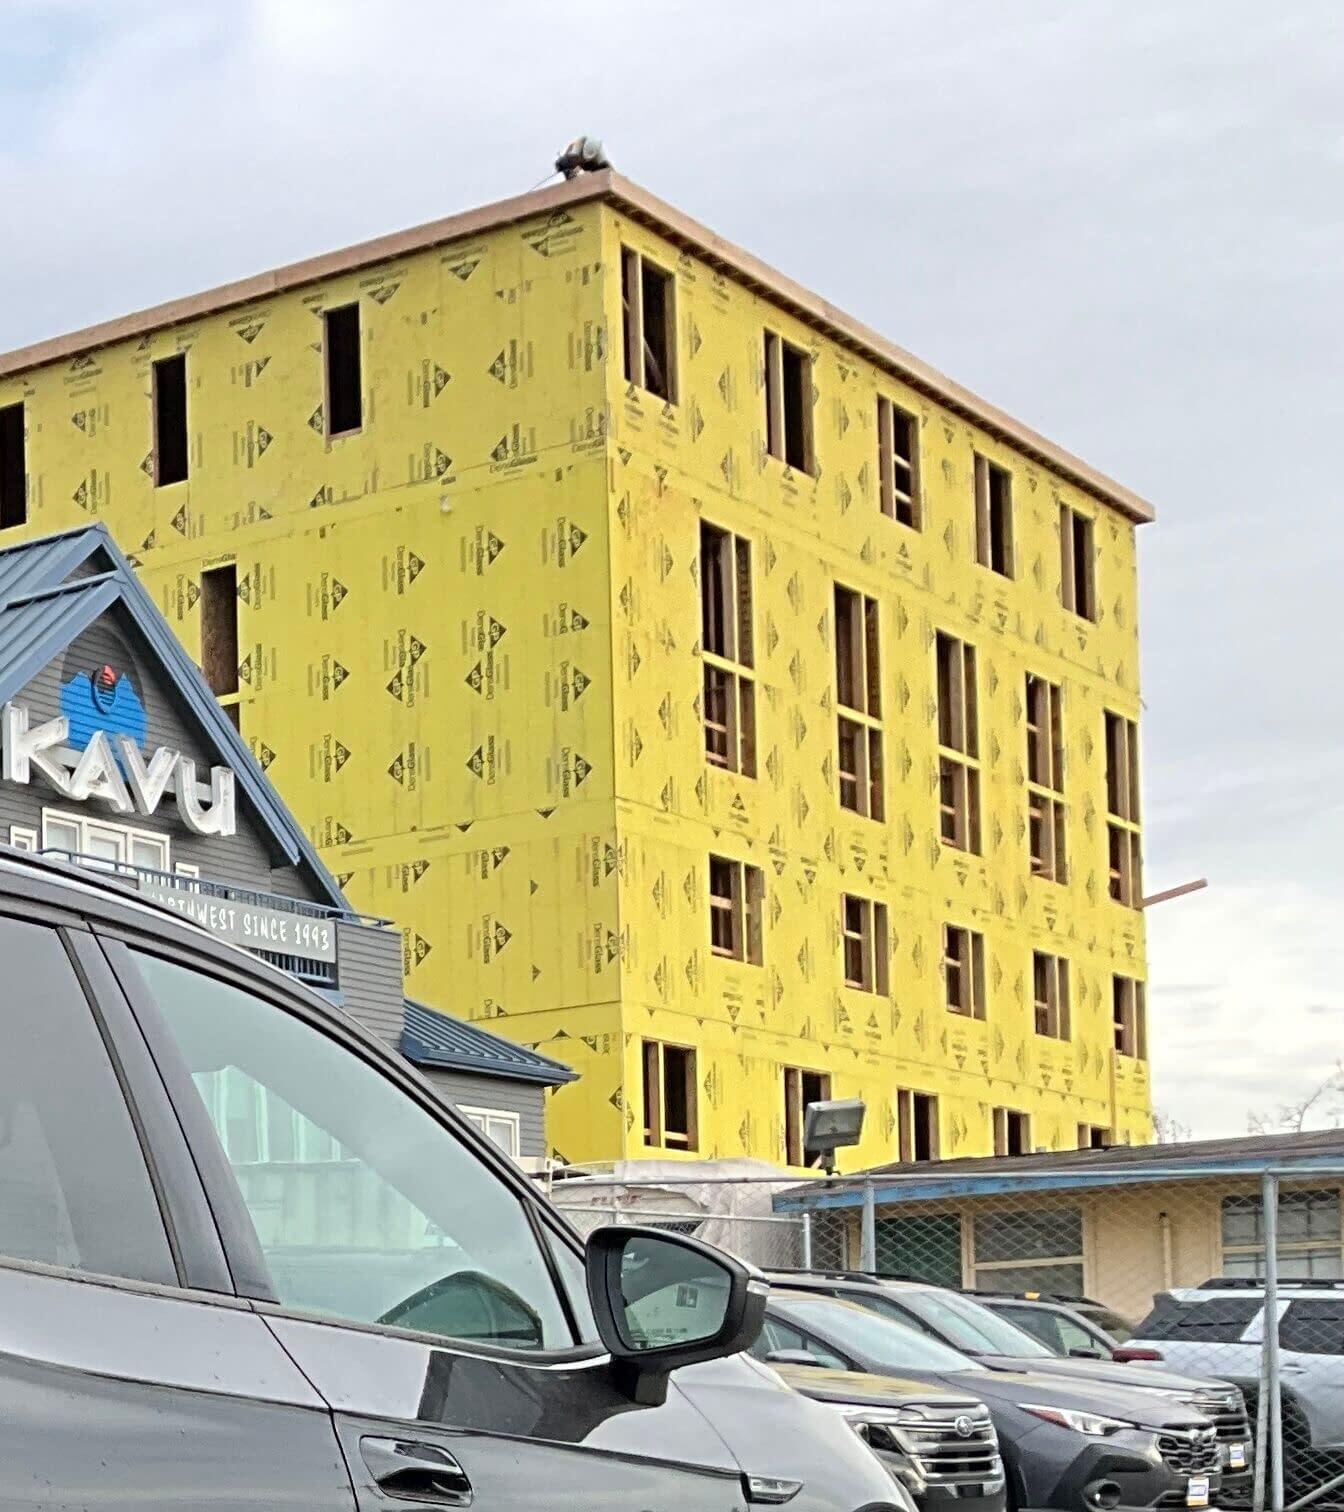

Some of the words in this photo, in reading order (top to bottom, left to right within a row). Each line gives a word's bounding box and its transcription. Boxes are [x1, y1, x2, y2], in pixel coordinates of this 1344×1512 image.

[1, 701, 237, 837] KAVU
[243, 913, 287, 942] SINCE
[294, 923, 330, 950] 1993
